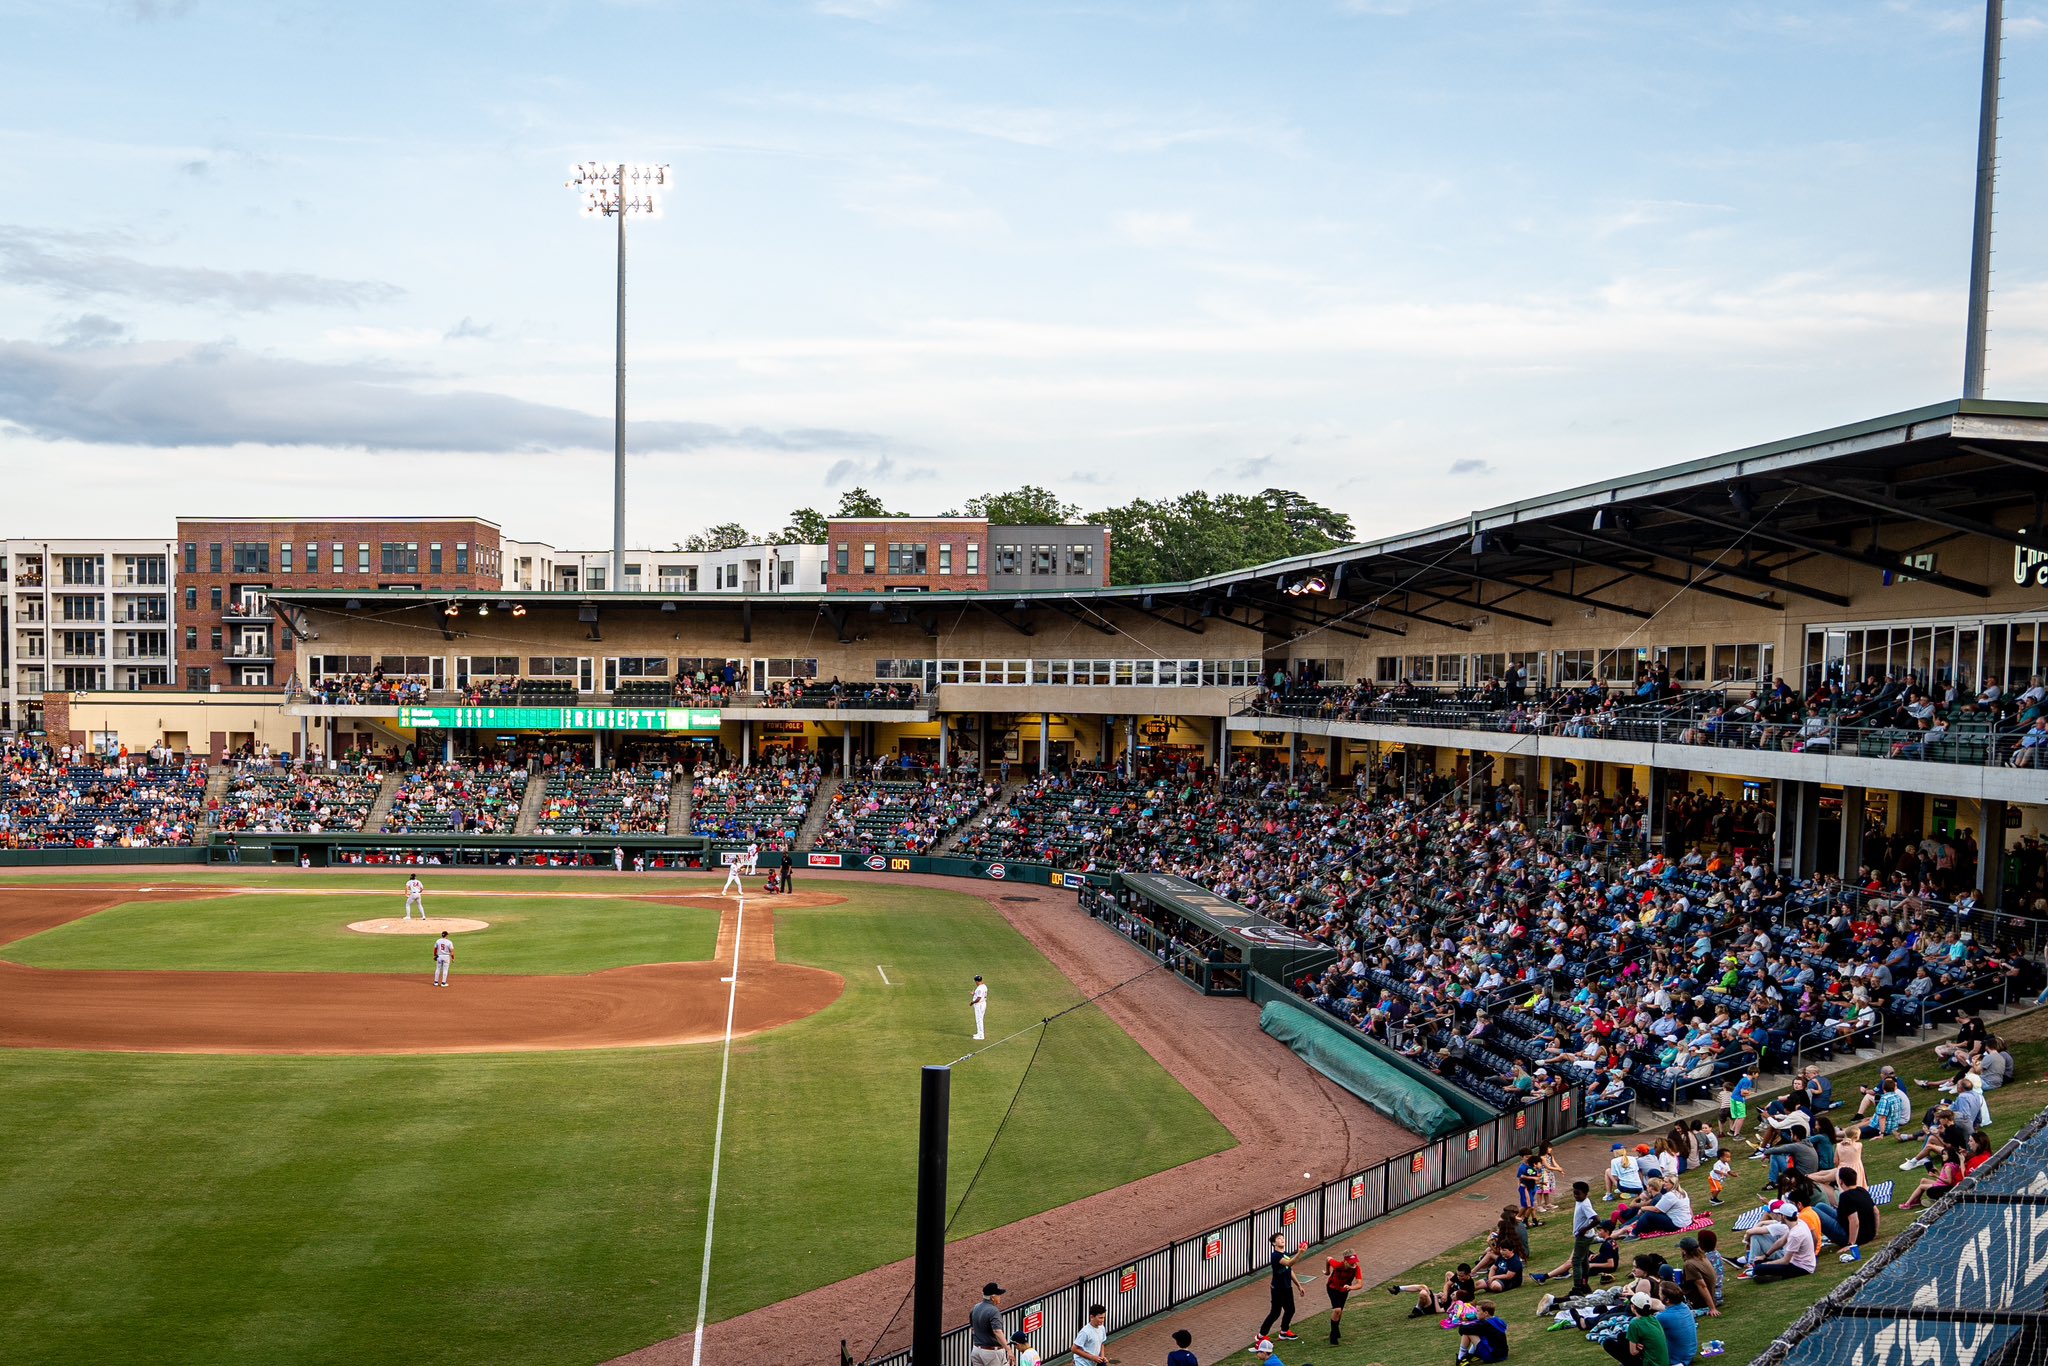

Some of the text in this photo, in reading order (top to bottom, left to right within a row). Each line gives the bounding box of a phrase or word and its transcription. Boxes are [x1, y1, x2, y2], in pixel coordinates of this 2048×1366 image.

[575, 711, 584, 727] R
[596, 711, 606, 727] H
[617, 711, 626, 727] E
